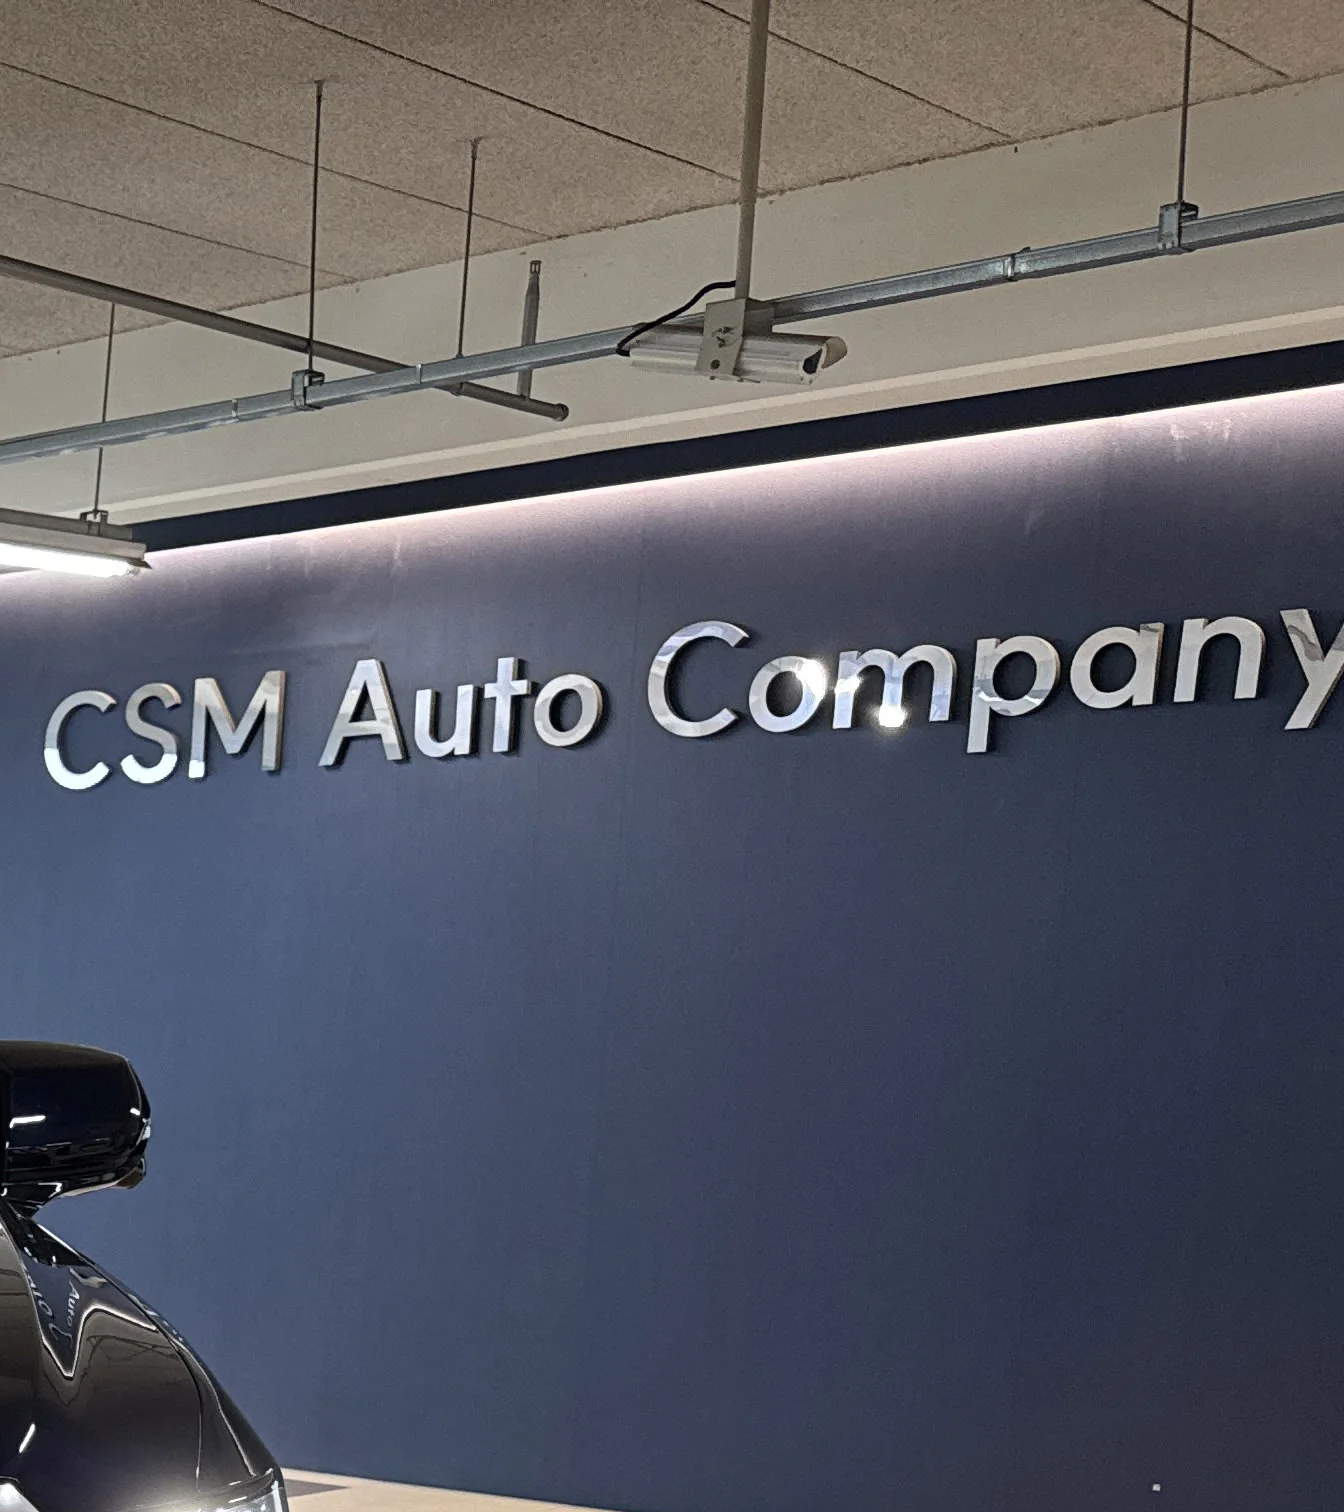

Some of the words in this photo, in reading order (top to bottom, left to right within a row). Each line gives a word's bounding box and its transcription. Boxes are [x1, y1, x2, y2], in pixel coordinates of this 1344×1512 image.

[43, 669, 286, 790] CSM
[318, 656, 606, 768] Auto
[647, 607, 1344, 753] Company
